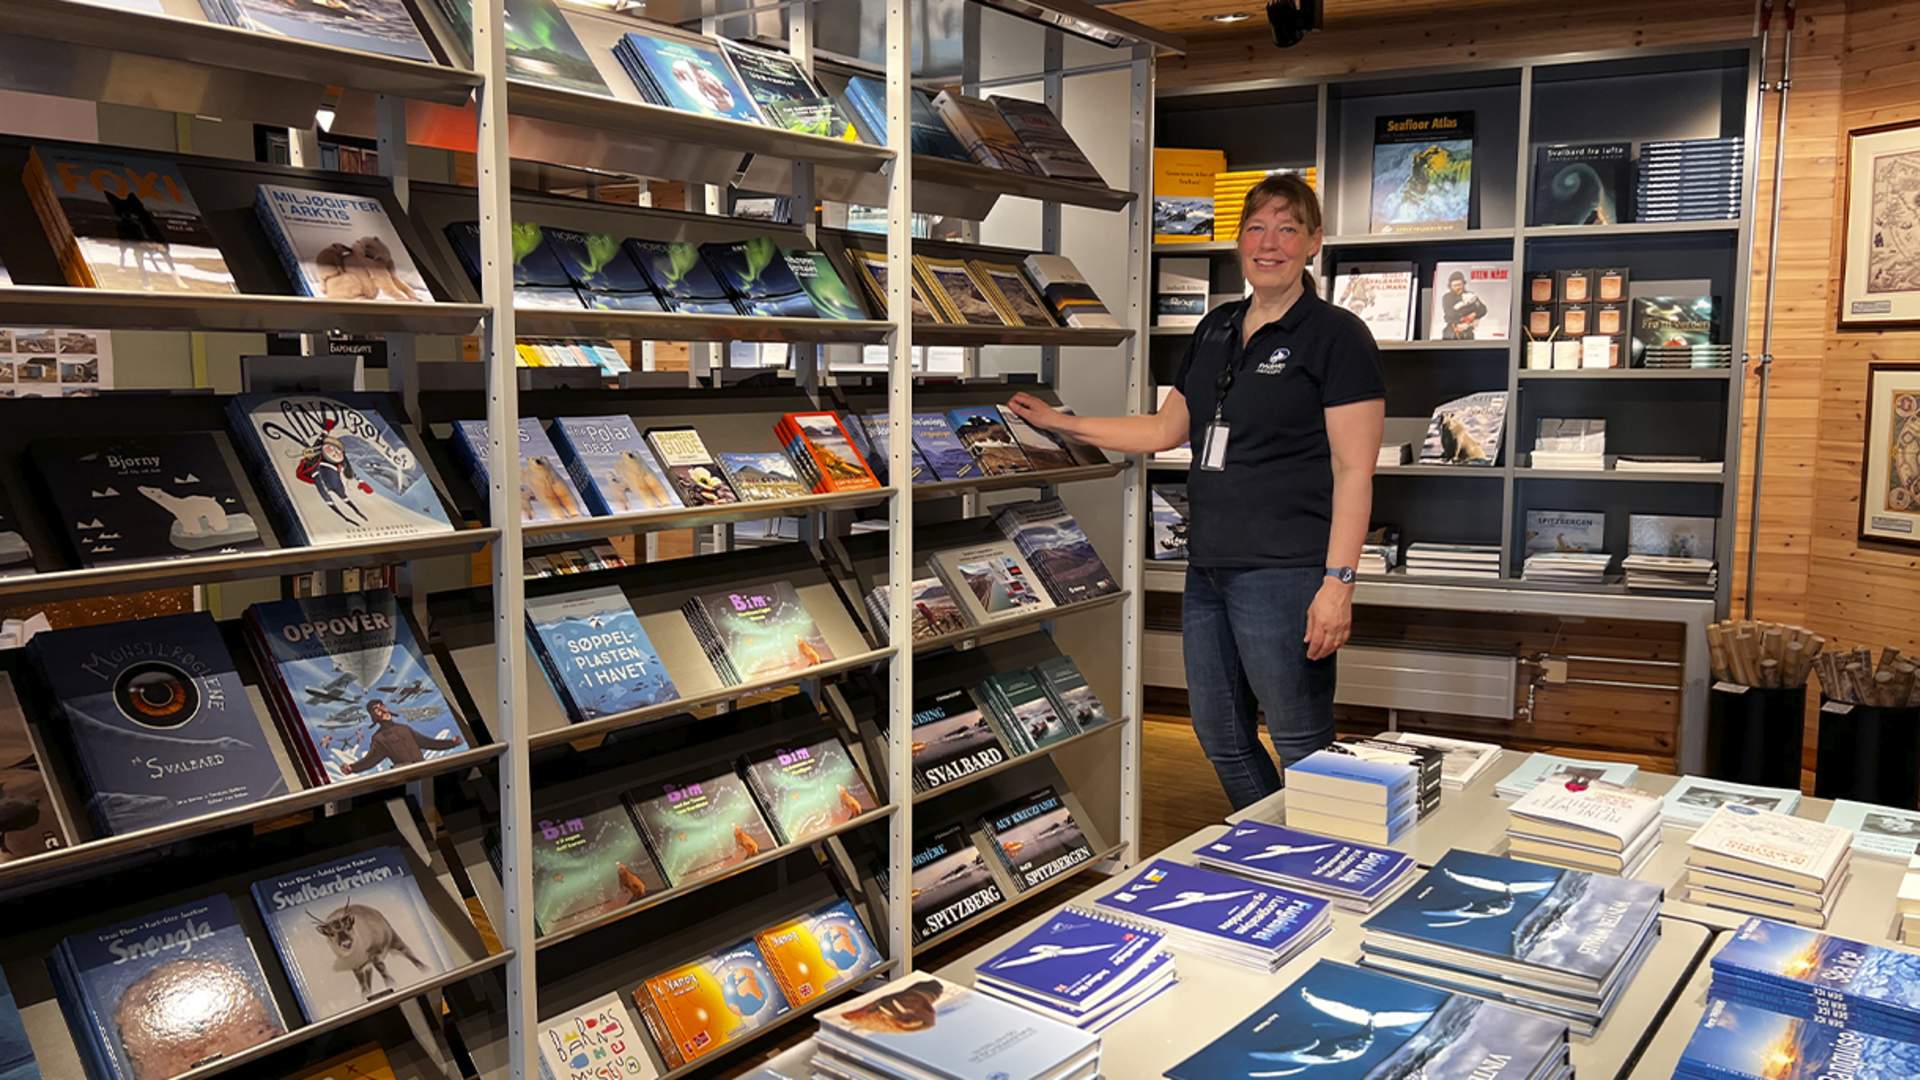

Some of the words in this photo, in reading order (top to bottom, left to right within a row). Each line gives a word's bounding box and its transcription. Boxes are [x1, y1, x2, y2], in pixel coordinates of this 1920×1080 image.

[1387, 118, 1430, 132] Seafloor
[1432, 117, 1458, 130] Atlas
[1547, 148, 1585, 158] Svalbard
[55, 161, 184, 204] FOXI
[272, 190, 382, 214] MILJØGIFTER
[290, 204, 350, 222] ARKTIS
[586, 423, 633, 442] Polar
[582, 441, 615, 455] bear
[729, 593, 766, 611] Bim
[282, 612, 391, 643] OPPOVER
[567, 631, 635, 654] SØPPEL-
[576, 646, 640, 670] PLASTEN
[584, 672, 593, 688] I
[598, 662, 647, 686] HAVET
[912, 705, 946, 727] UISING
[146, 753, 225, 779] SVALBARD
[925, 746, 1003, 788] SVALBARD
[912, 842, 948, 870] OISIÈRE
[1025, 845, 1093, 887] SPITZBERGEN
[272, 865, 393, 911] Svalbardreinen
[925, 885, 1001, 934] SPITZBERG
[109, 918, 215, 965] Snøugla
